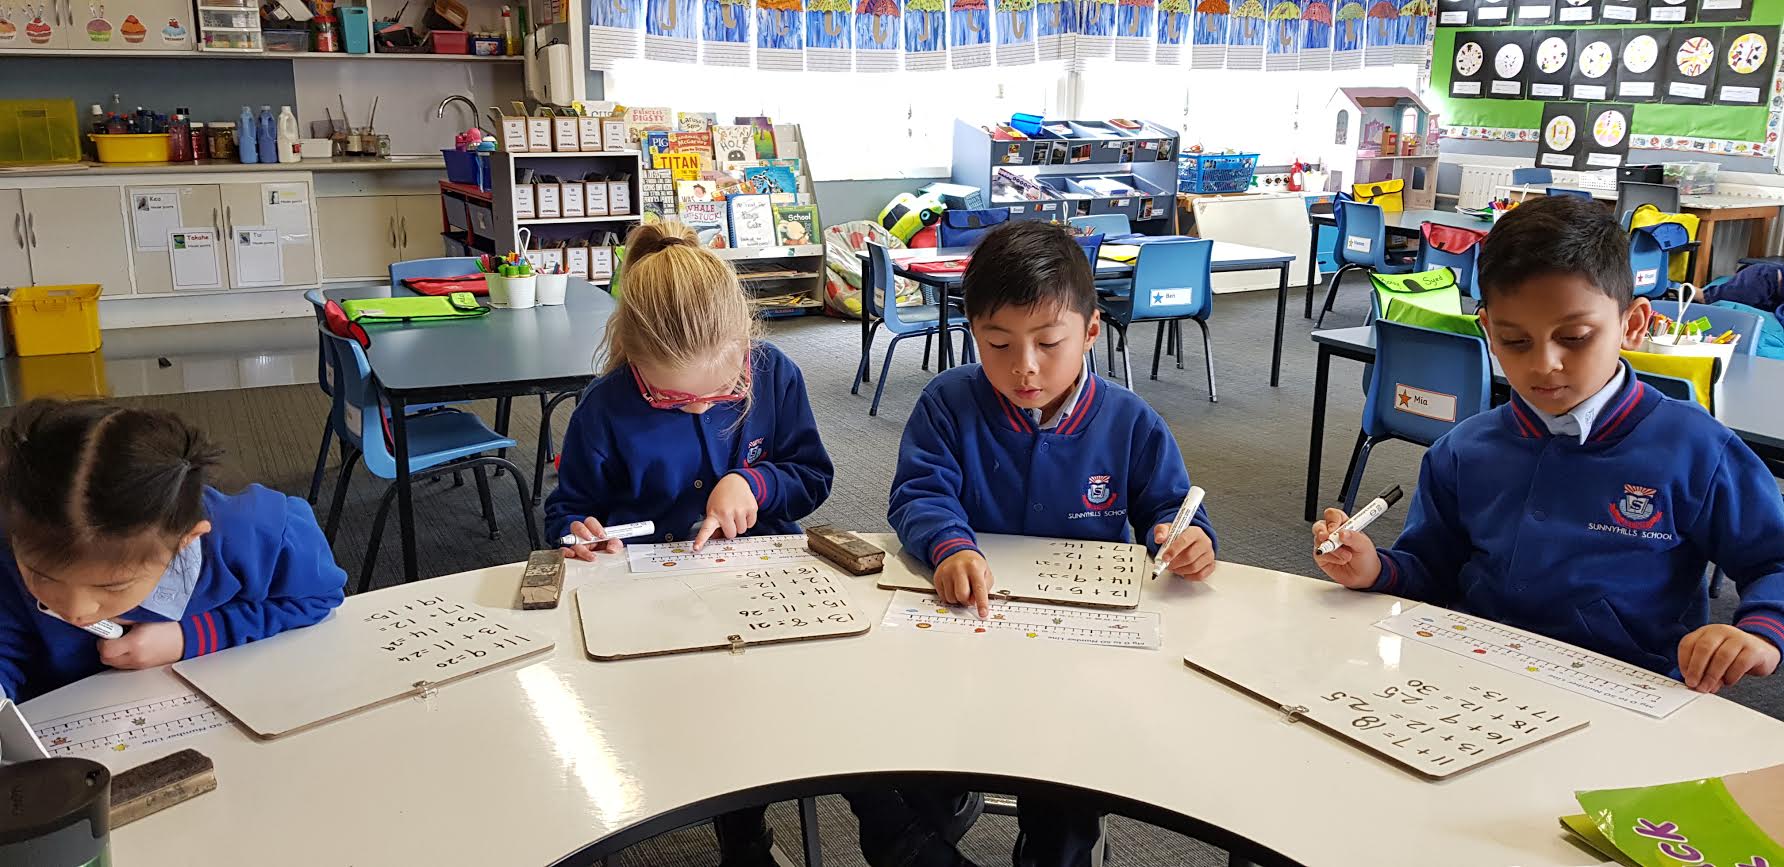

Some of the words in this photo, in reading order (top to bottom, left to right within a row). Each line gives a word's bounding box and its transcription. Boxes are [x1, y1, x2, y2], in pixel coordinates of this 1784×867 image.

[652, 137, 669, 147] PIG
[720, 139, 749, 152] HOLE
[660, 156, 699, 169] TITAN
[685, 204, 715, 213] WHALE
[788, 213, 811, 221] School
[1422, 275, 1444, 286] Syed
[1413, 395, 1428, 406] Mia
[1630, 500, 1643, 510] S
[1067, 511, 1101, 519] SUNNYHILLS
[1588, 522, 1638, 537] SUNNYHILLS
[1641, 531, 1673, 541] SCHOOL
[1063, 551, 1082, 560] 12
[1112, 555, 1133, 563] 15
[798, 566, 819, 575] 18
[1113, 565, 1134, 573] 16
[746, 571, 771, 579] 15
[805, 576, 830, 584] 12
[1073, 574, 1087, 583] 9
[1110, 576, 1131, 585] 14
[814, 586, 836, 595] 14
[1069, 586, 1083, 595] 5
[1109, 590, 1128, 598] 12
[416, 596, 444, 606] 19
[761, 591, 786, 601] 13
[782, 604, 796, 613] 11
[822, 599, 847, 608] 15
[438, 604, 465, 614] 17
[791, 617, 808, 627] 8
[827, 613, 854, 623] 13
[390, 618, 416, 629] 12
[749, 622, 771, 630] 21
[409, 627, 439, 638] 14
[478, 623, 509, 635] 13
[433, 639, 455, 651] 11
[1407, 678, 1440, 696] 30
[1482, 690, 1508, 703] 13
[1459, 698, 1484, 712] 12
[1439, 713, 1462, 725] 9
[1531, 710, 1560, 723] 17
[1405, 719, 1435, 734] 12
[1510, 719, 1539, 735] 18
[170, 726, 207, 739] Number
[142, 737, 164, 745] Line
[1391, 737, 1412, 749] 7
[1486, 731, 1513, 745] 16
[1457, 742, 1485, 756] 13
[1430, 755, 1455, 766] 11
